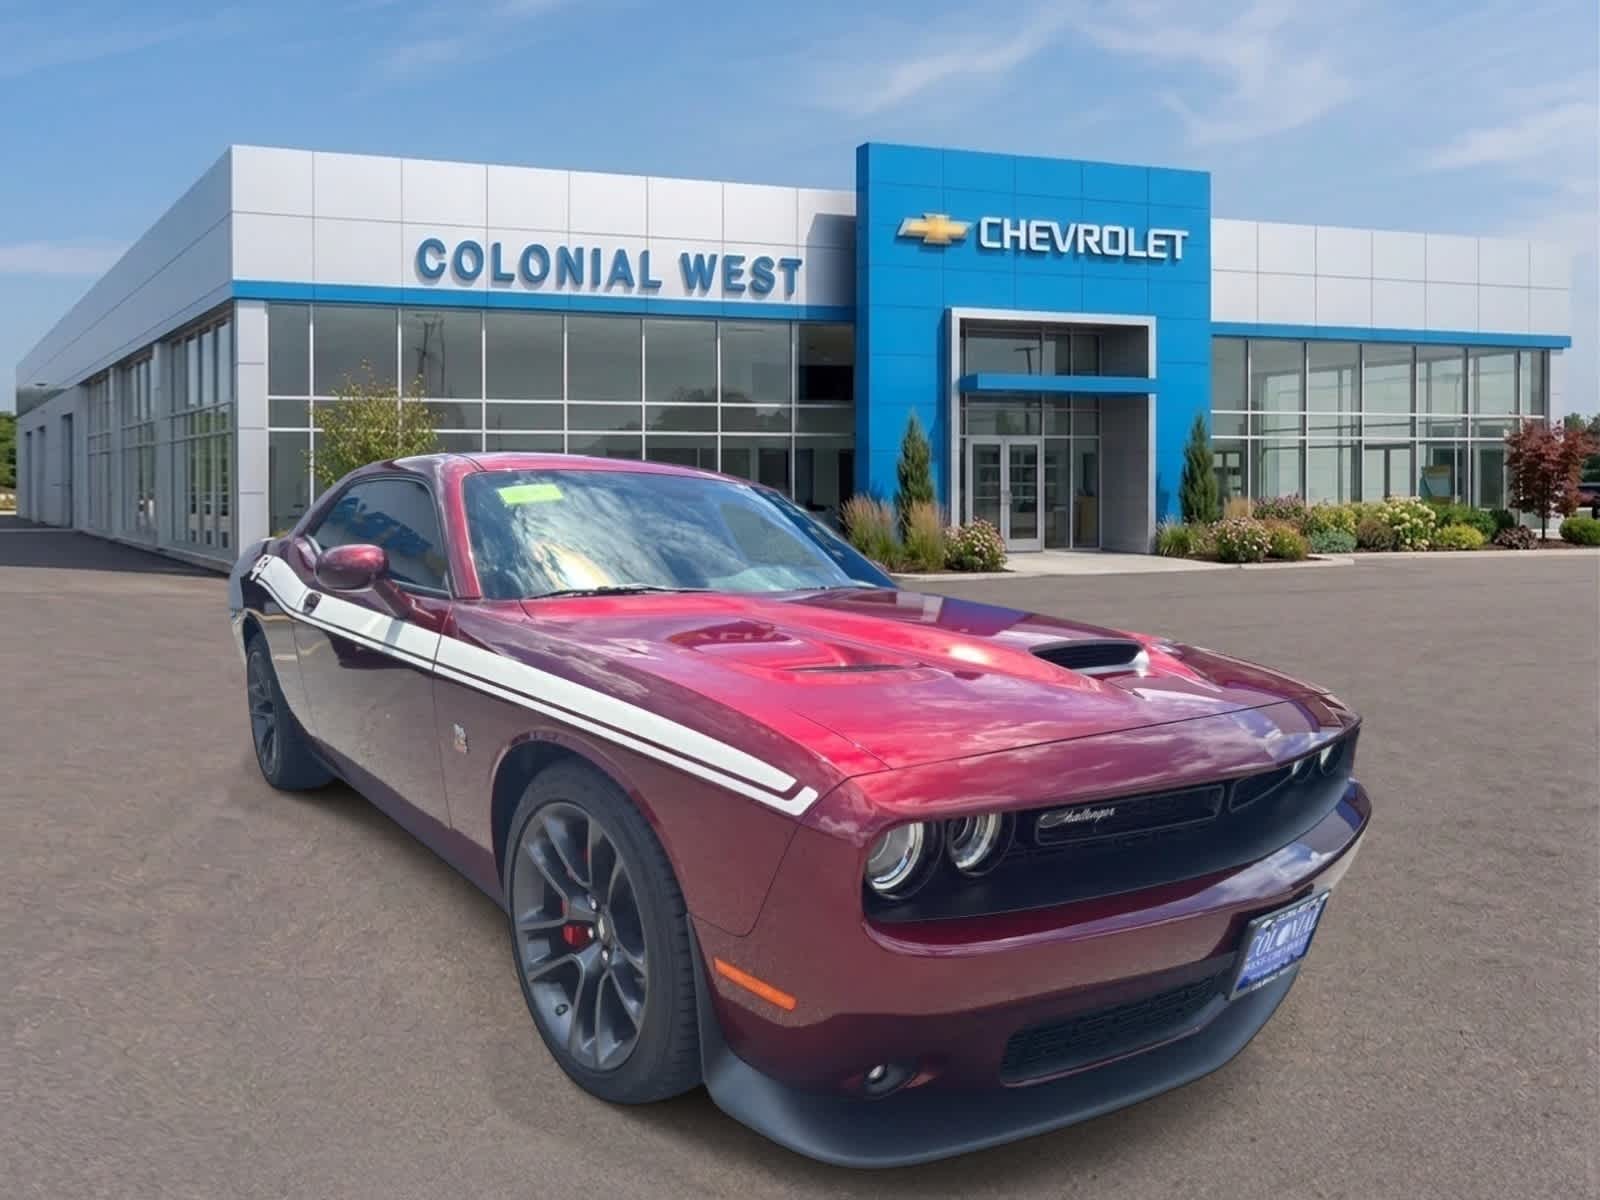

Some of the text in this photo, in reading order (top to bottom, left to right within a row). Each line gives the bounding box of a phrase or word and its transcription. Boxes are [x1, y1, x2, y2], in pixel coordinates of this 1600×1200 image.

[979, 216, 1190, 260] CHEVROLET
[416, 238, 803, 297] COLONIAL WEST
